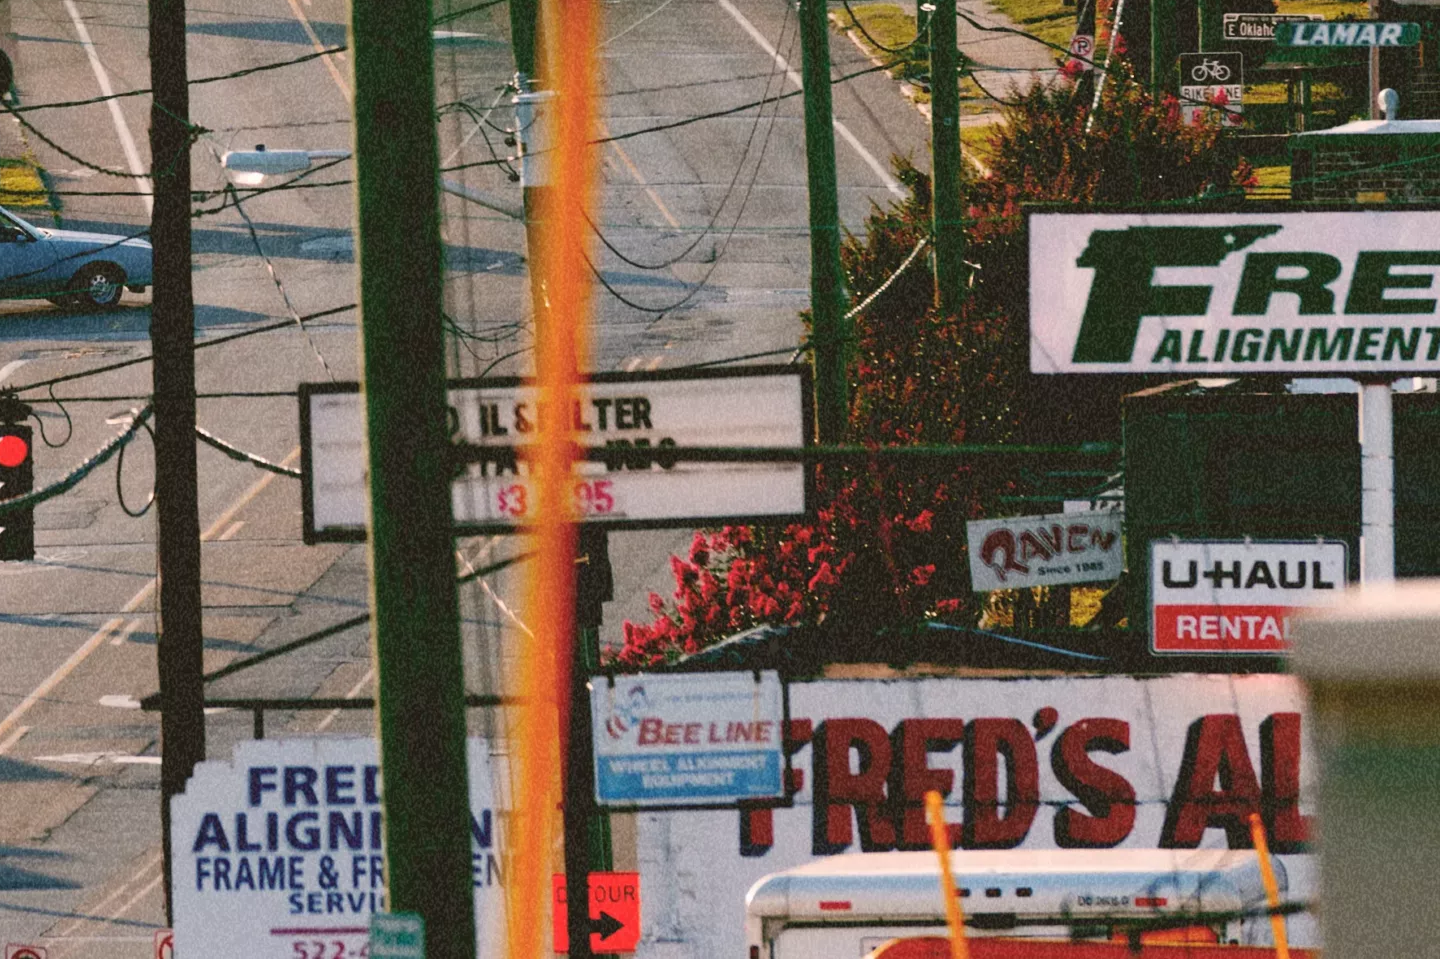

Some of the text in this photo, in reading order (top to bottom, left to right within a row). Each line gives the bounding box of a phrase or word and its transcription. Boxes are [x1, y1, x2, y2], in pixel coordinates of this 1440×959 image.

[1228, 24, 1235, 36] E
[1291, 23, 1403, 45] LAMAR
[1071, 224, 1440, 364] FRE
[979, 523, 1117, 582] RAVEN
[1037, 564, 1072, 576] Since
[1162, 560, 1335, 589] U-HAUL
[637, 716, 774, 746] BEE LINE
[196, 856, 305, 891] FRAME
[318, 855, 339, 890] &
[288, 892, 384, 915] SERVI
[292, 940, 369, 959] 522-
